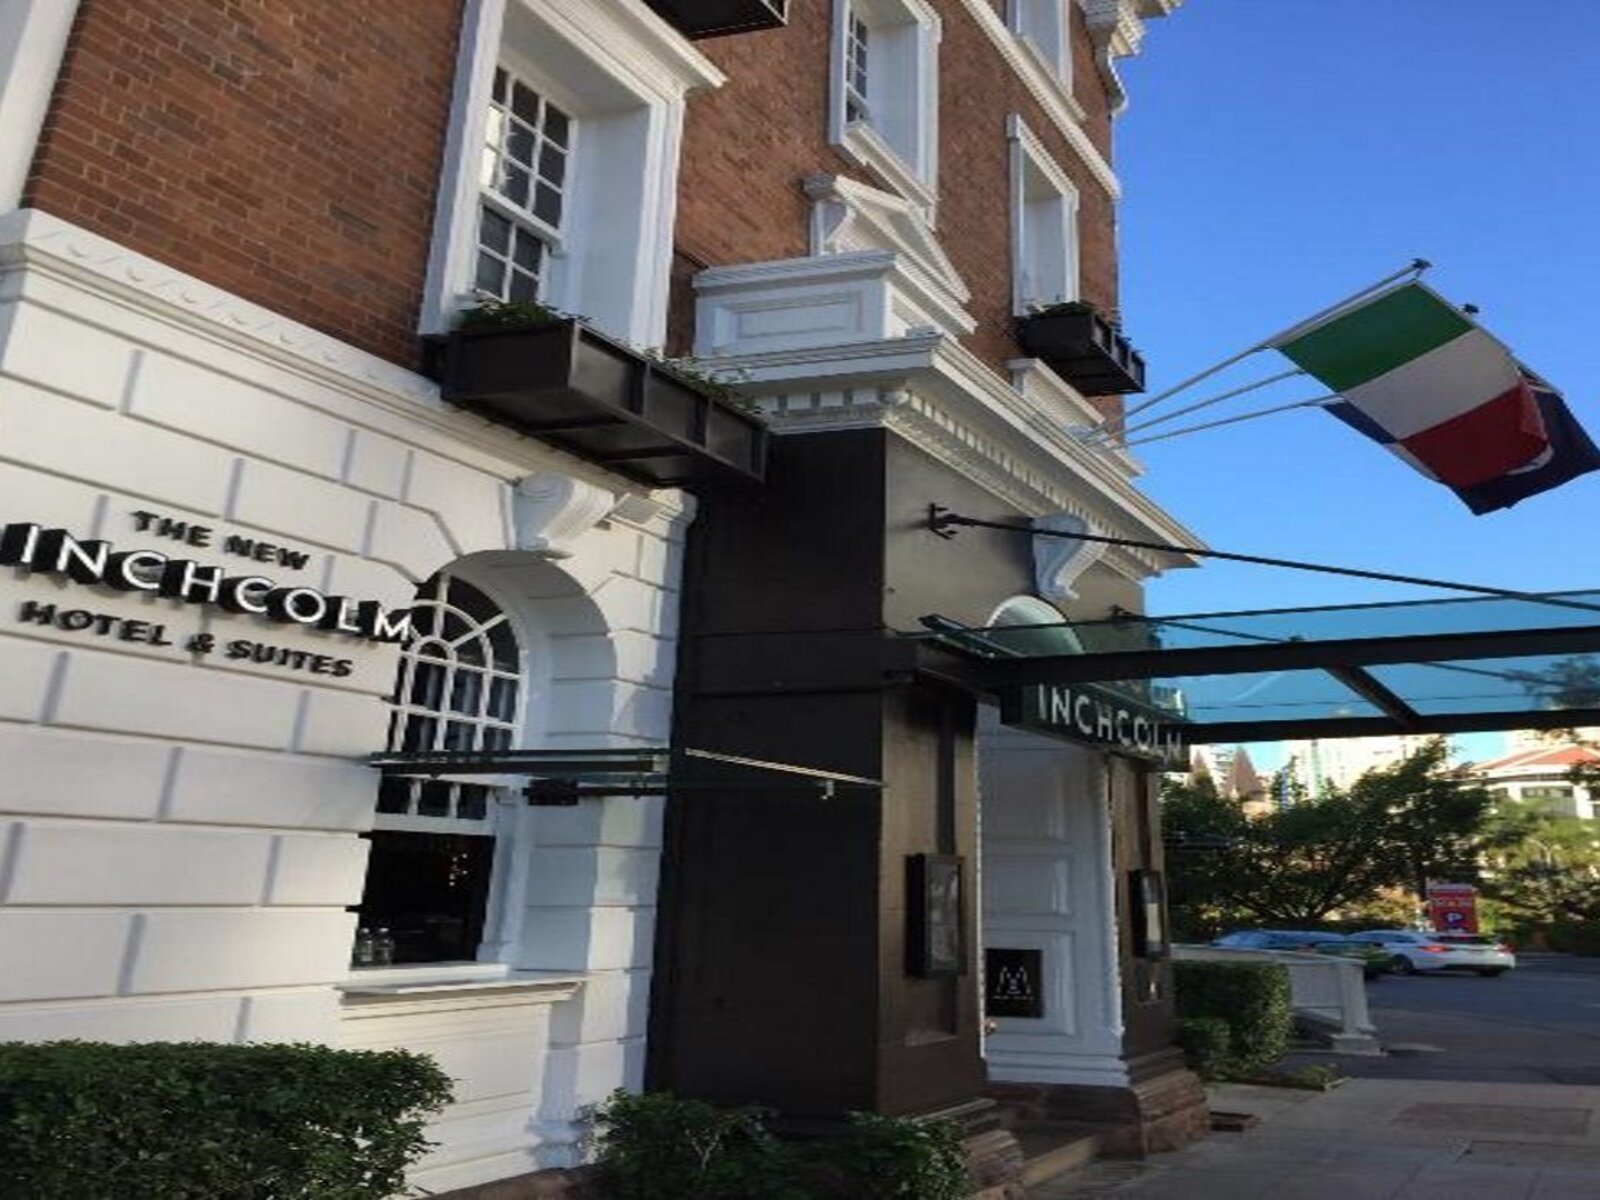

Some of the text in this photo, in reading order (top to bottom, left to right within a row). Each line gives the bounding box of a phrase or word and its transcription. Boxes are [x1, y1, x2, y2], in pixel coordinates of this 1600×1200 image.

[133, 509, 311, 570] THE NEW
[8, 523, 412, 641] INCHCOLM
[19, 600, 353, 678] HOTEL & SUITES
